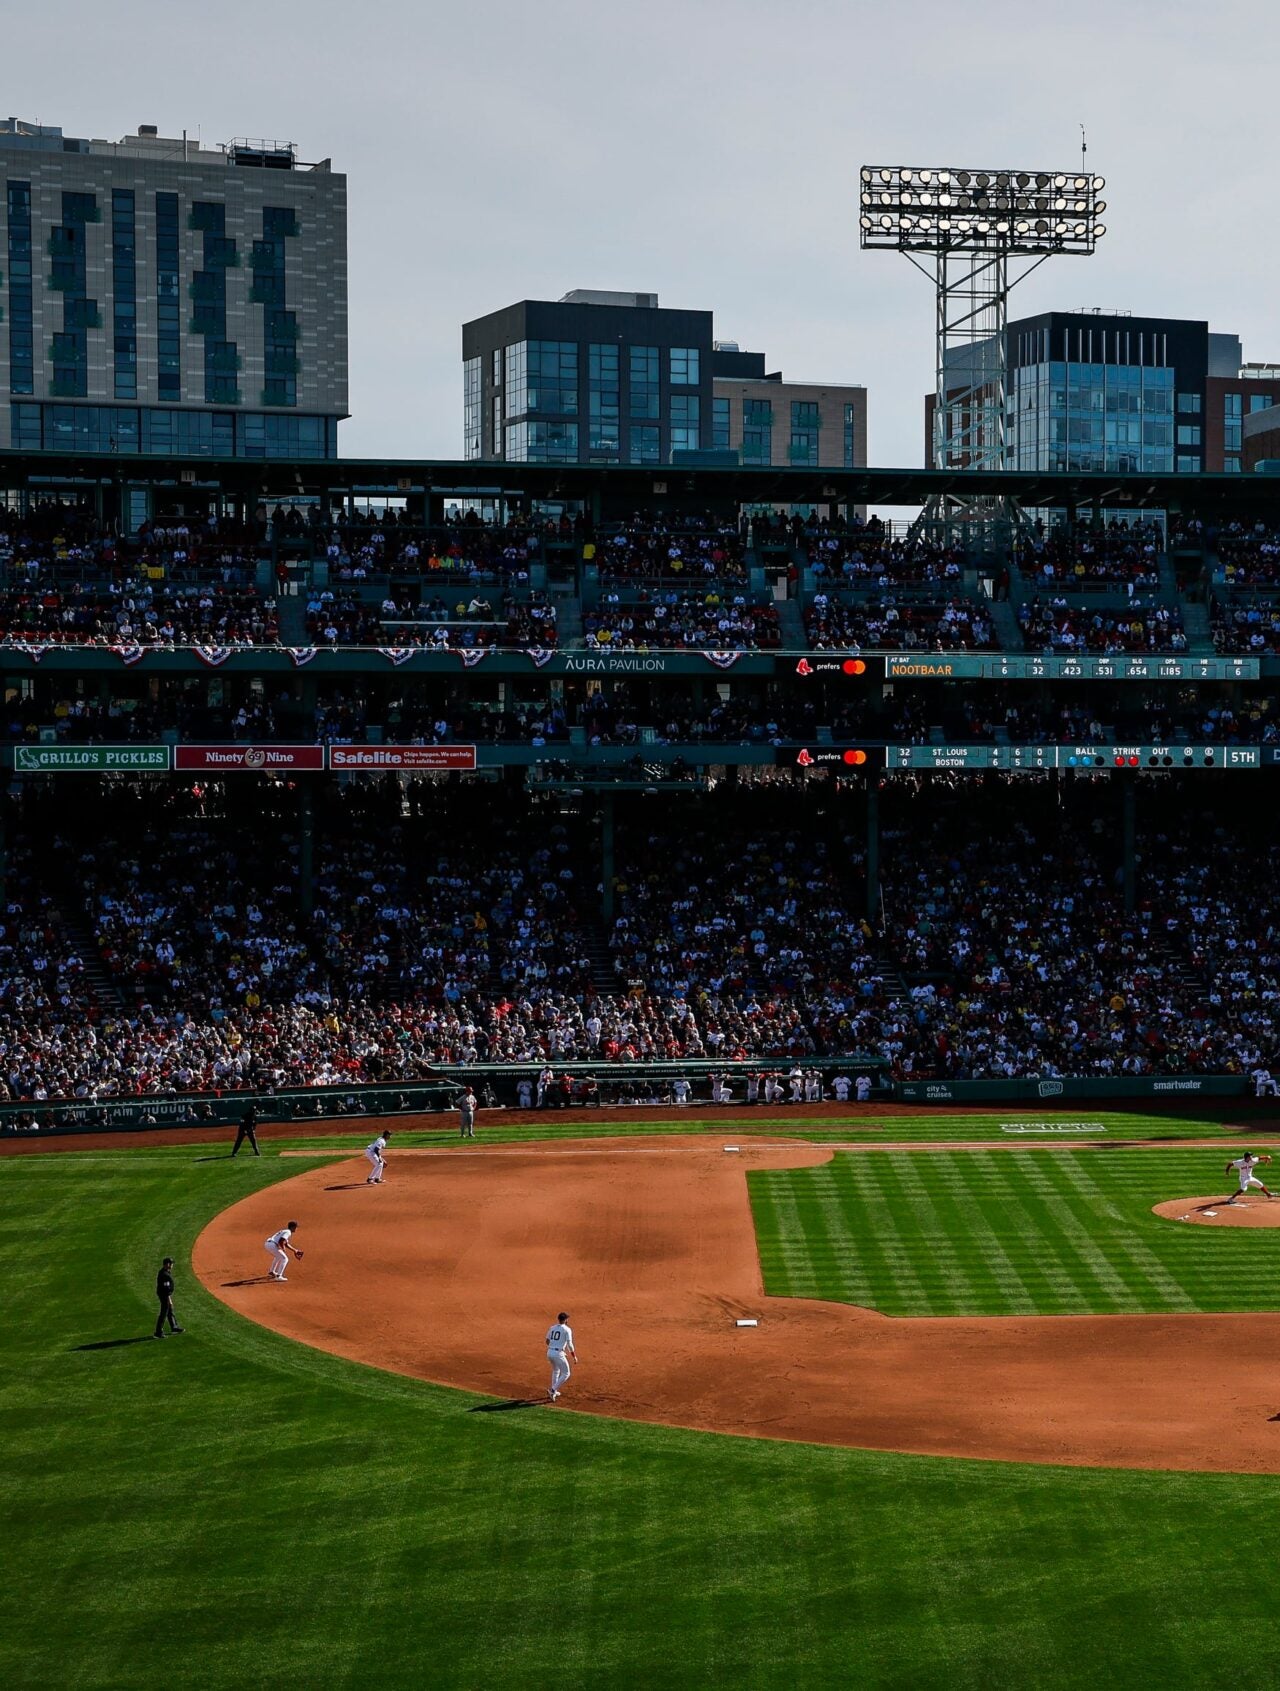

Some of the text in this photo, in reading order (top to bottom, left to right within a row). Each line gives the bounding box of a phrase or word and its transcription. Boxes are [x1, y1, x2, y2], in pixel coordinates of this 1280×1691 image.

[609, 659, 665, 670] PAVILION
[817, 663, 840, 671] prefers
[892, 665, 952, 675] NOOTBAAR
[1033, 667, 1043, 675] 32
[1061, 667, 1081, 675] .423
[1096, 667, 1113, 675] .531
[1127, 667, 1147, 675] .654
[1160, 667, 1181, 675] 1.185
[1201, 667, 1207, 675] 2
[1235, 667, 1241, 675] 6
[900, 748, 910, 756] 32
[1075, 747, 1097, 755] BALL
[1113, 747, 1141, 755] STRIKE
[1152, 747, 1169, 755] OUT
[39, 752, 164, 764] GRILLO'S PICKLES
[205, 752, 244, 764] Ninety
[266, 753, 294, 762] Nine
[333, 751, 402, 764] Safelite
[817, 753, 841, 761] prefers
[935, 758, 965, 766] BOSTON
[993, 758, 998, 766] 6
[1015, 758, 1020, 766] 5
[1037, 758, 1042, 766] 0
[1231, 752, 1255, 762] 5TH
[1153, 1079, 1202, 1090] smartwater
[550, 1330, 561, 1341] 10
